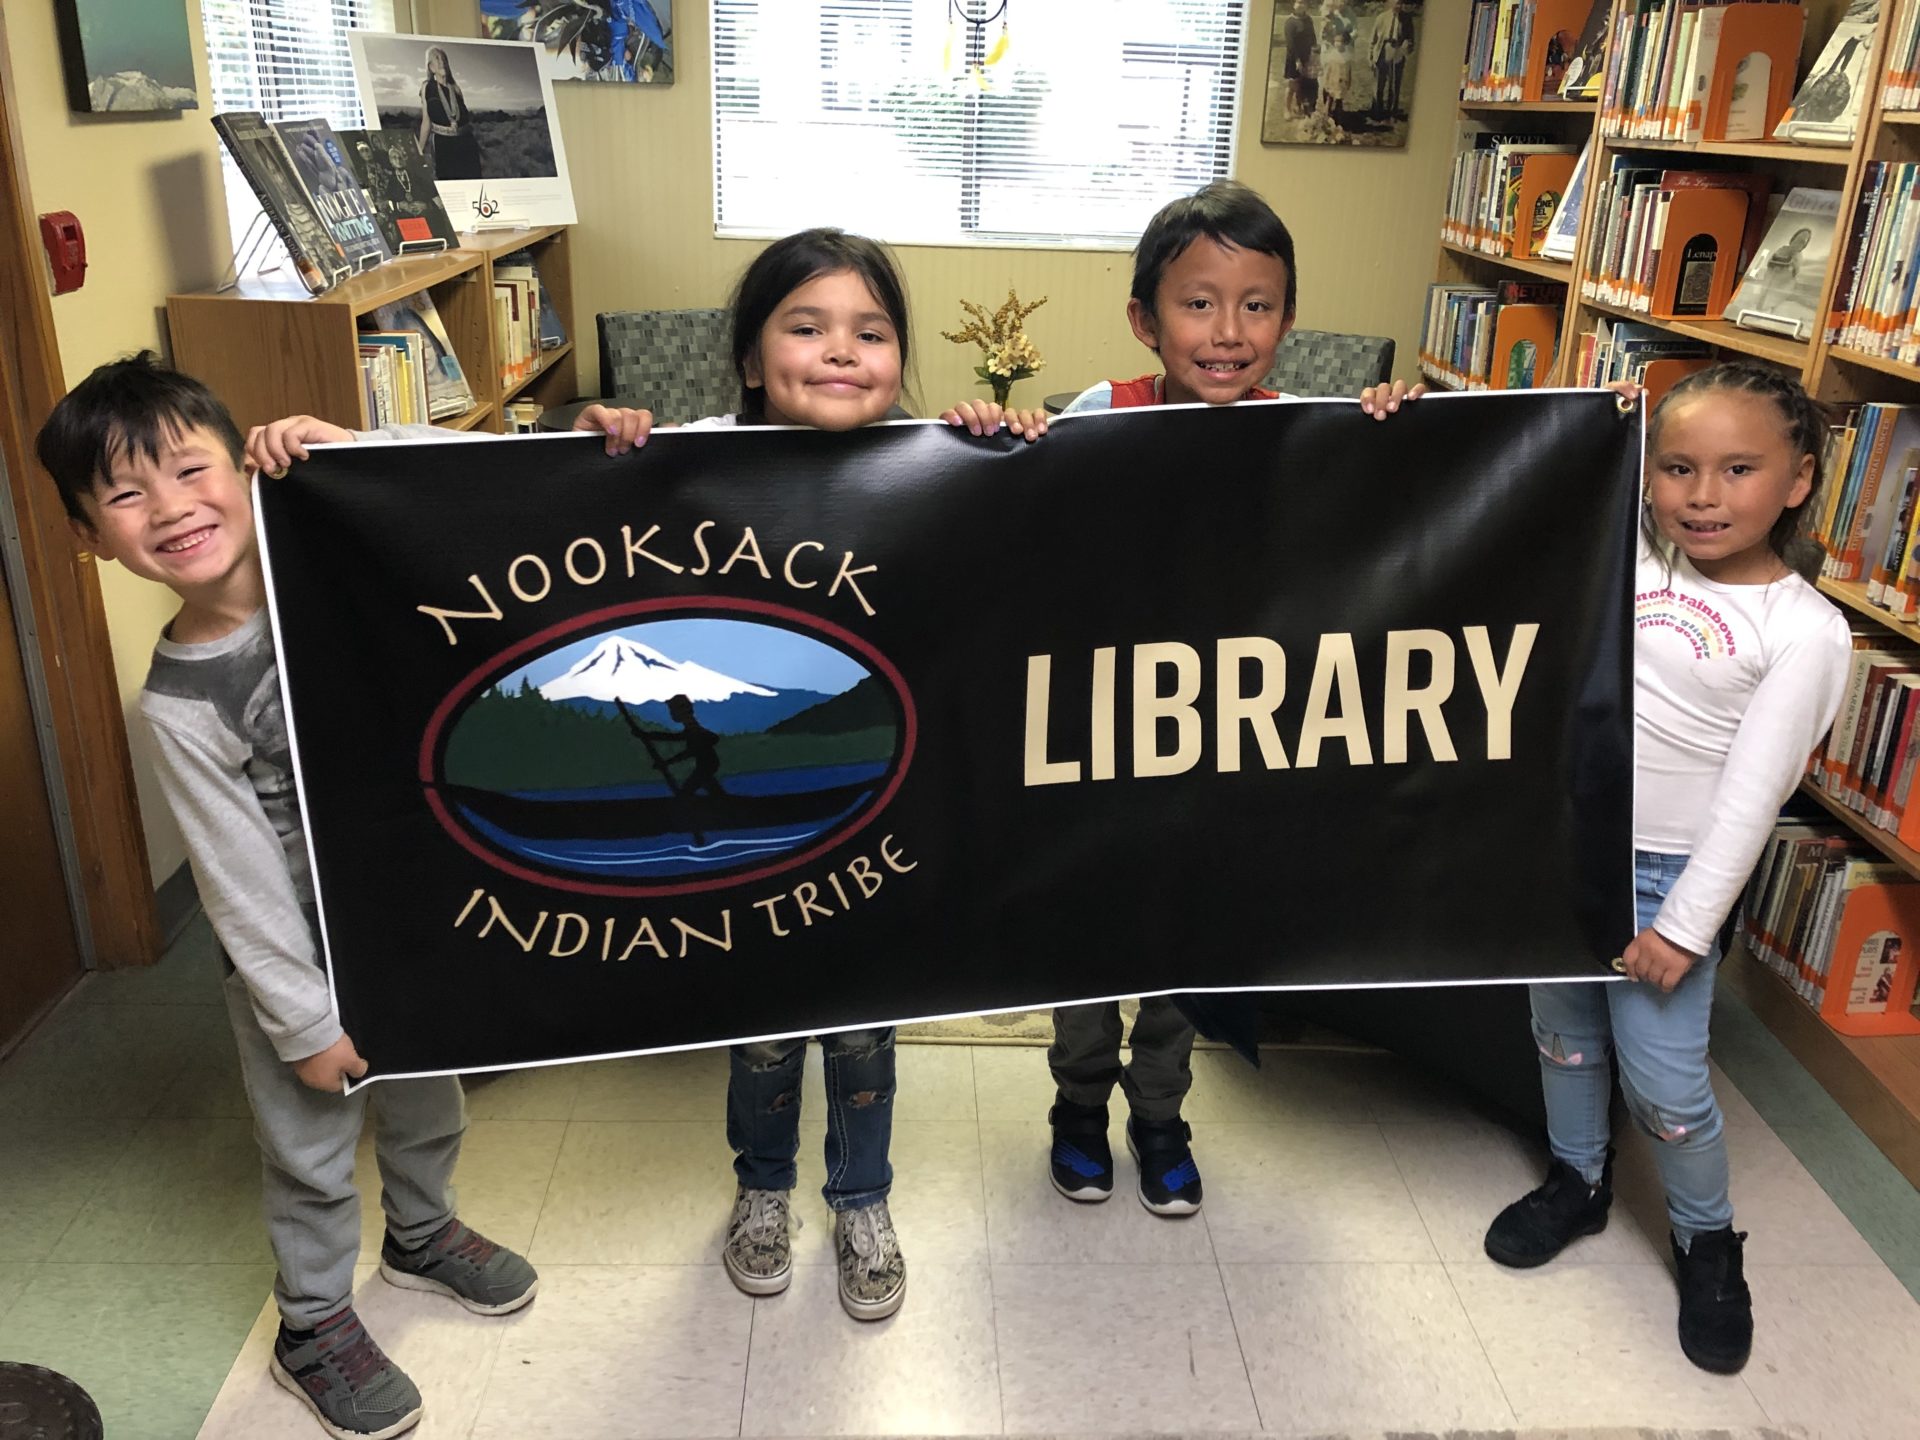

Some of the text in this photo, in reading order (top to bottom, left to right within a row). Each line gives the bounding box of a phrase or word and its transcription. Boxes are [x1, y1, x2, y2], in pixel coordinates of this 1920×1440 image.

[317, 188, 367, 223] VOGUE
[472, 183, 500, 219] 562
[1687, 247, 1717, 263] Lenap
[417, 520, 878, 645] NOOKSACK
[1636, 612, 1710, 659] more glitter
[1679, 593, 1736, 656] rainbows
[1679, 603, 1724, 653] cupcakes
[1024, 623, 1540, 786] LIBRARY
[454, 834, 918, 961] INDIAN TRIBE
